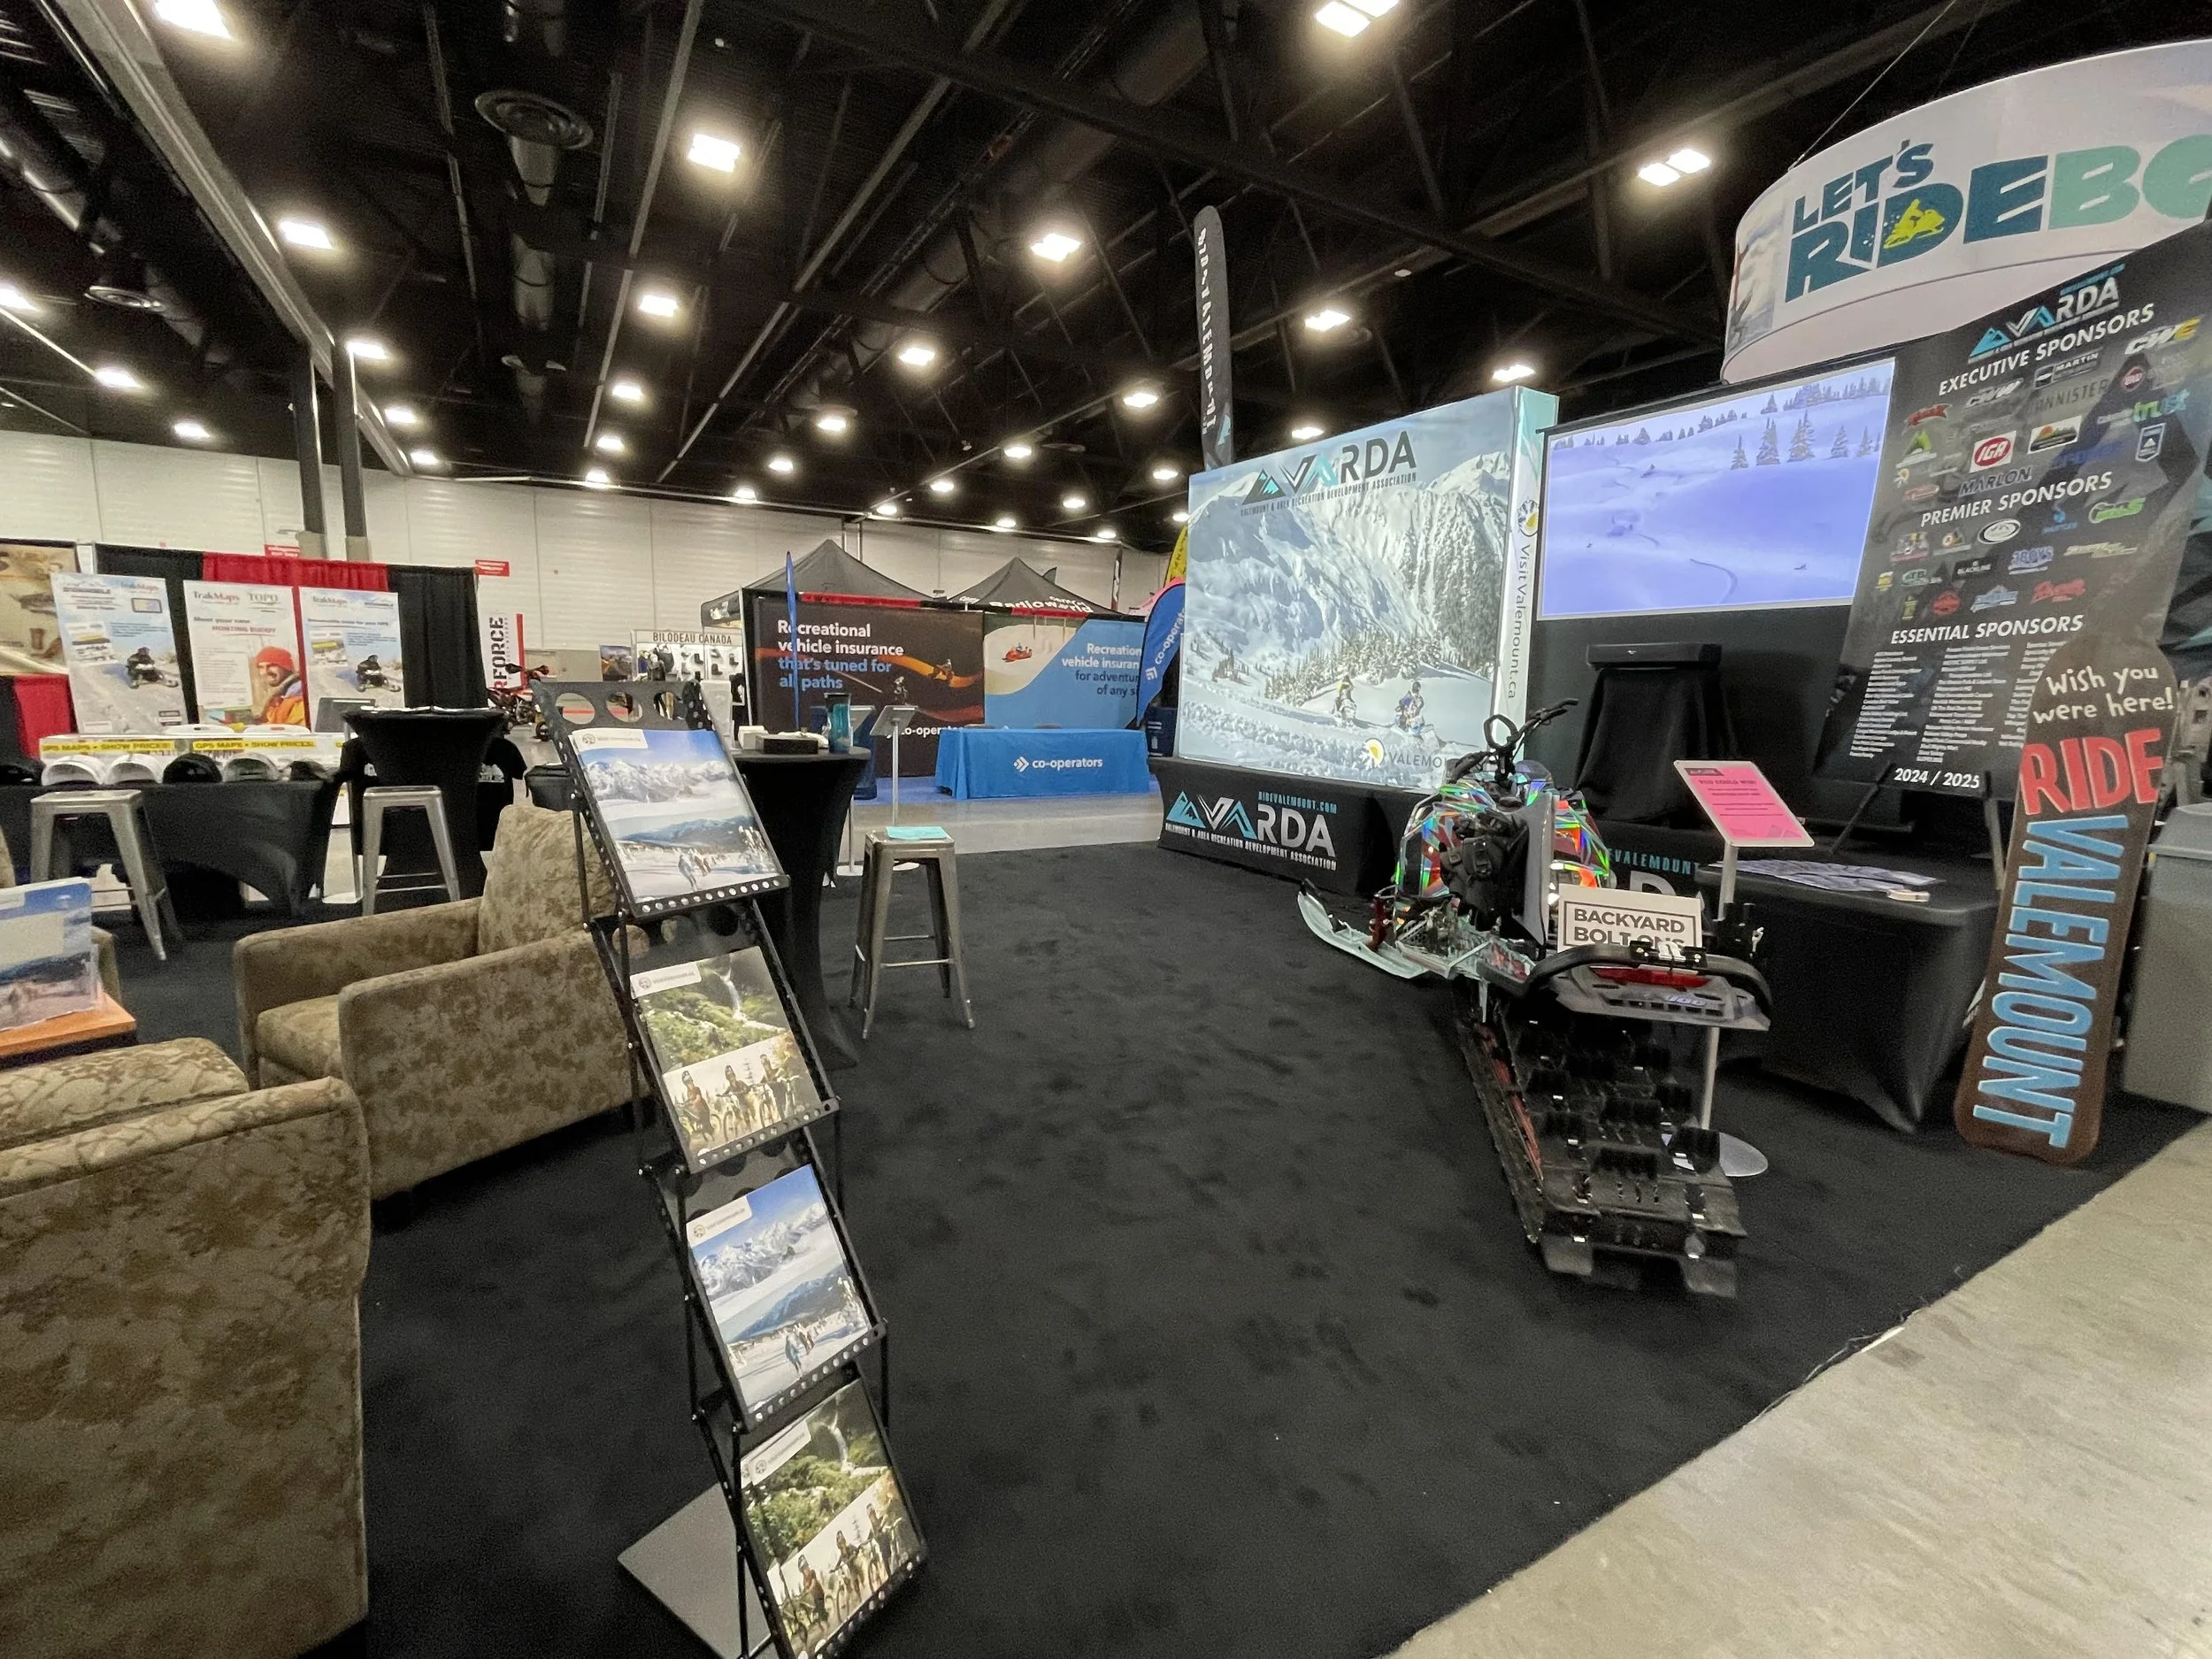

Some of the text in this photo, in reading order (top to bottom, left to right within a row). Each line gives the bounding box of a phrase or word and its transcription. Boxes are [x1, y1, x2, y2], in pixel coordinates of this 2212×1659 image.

[1793, 139, 1934, 234] LET'S
[1939, 349, 2030, 396] EXECUTIVE
[2035, 303, 2154, 363] SPONSORS
[2055, 353, 2100, 372] MARTIN
[1977, 441, 2009, 464] IGA
[1292, 492, 1325, 509] RECREATION
[1327, 481, 1369, 500] DEVELOPMENT
[1371, 472, 1417, 491] ASSOCIATION
[1958, 466, 2033, 497] MARLON
[1921, 499, 1992, 528] PREMIER
[1998, 472, 2113, 511] SPONSORS
[1508, 544, 1531, 699] VisitValemount.ca
[1891, 614, 2085, 645] ESSENTIAL SPONSORS
[653, 632, 733, 645] BILODEAU CANADA
[836, 640, 904, 657] insurance
[825, 657, 868, 672] tuned
[871, 658, 892, 673] for
[1062, 657, 1100, 668] vehicle
[780, 673, 843, 692] al paths
[1075, 671, 1090, 681] for
[2046, 665, 2159, 695] Wish you
[1097, 684, 1108, 695] of
[1110, 687, 1129, 698] any
[2033, 687, 2174, 724] were here!
[1032, 757, 1103, 772] co-operators
[1389, 752, 1447, 769] VALEMO
[2019, 727, 2164, 816] RIDE
[1893, 768, 1980, 789] 2024 / 2025
[1210, 832, 1243, 849] RECREATION
[1245, 841, 1287, 861] DEVELOPMENT
[1290, 850, 1337, 872] ASSOCIATION
[1574, 909, 1685, 933] BACKYARD
[1574, 926, 1632, 946] BOLT
[1973, 814, 2130, 1148] VALEMOUNT
